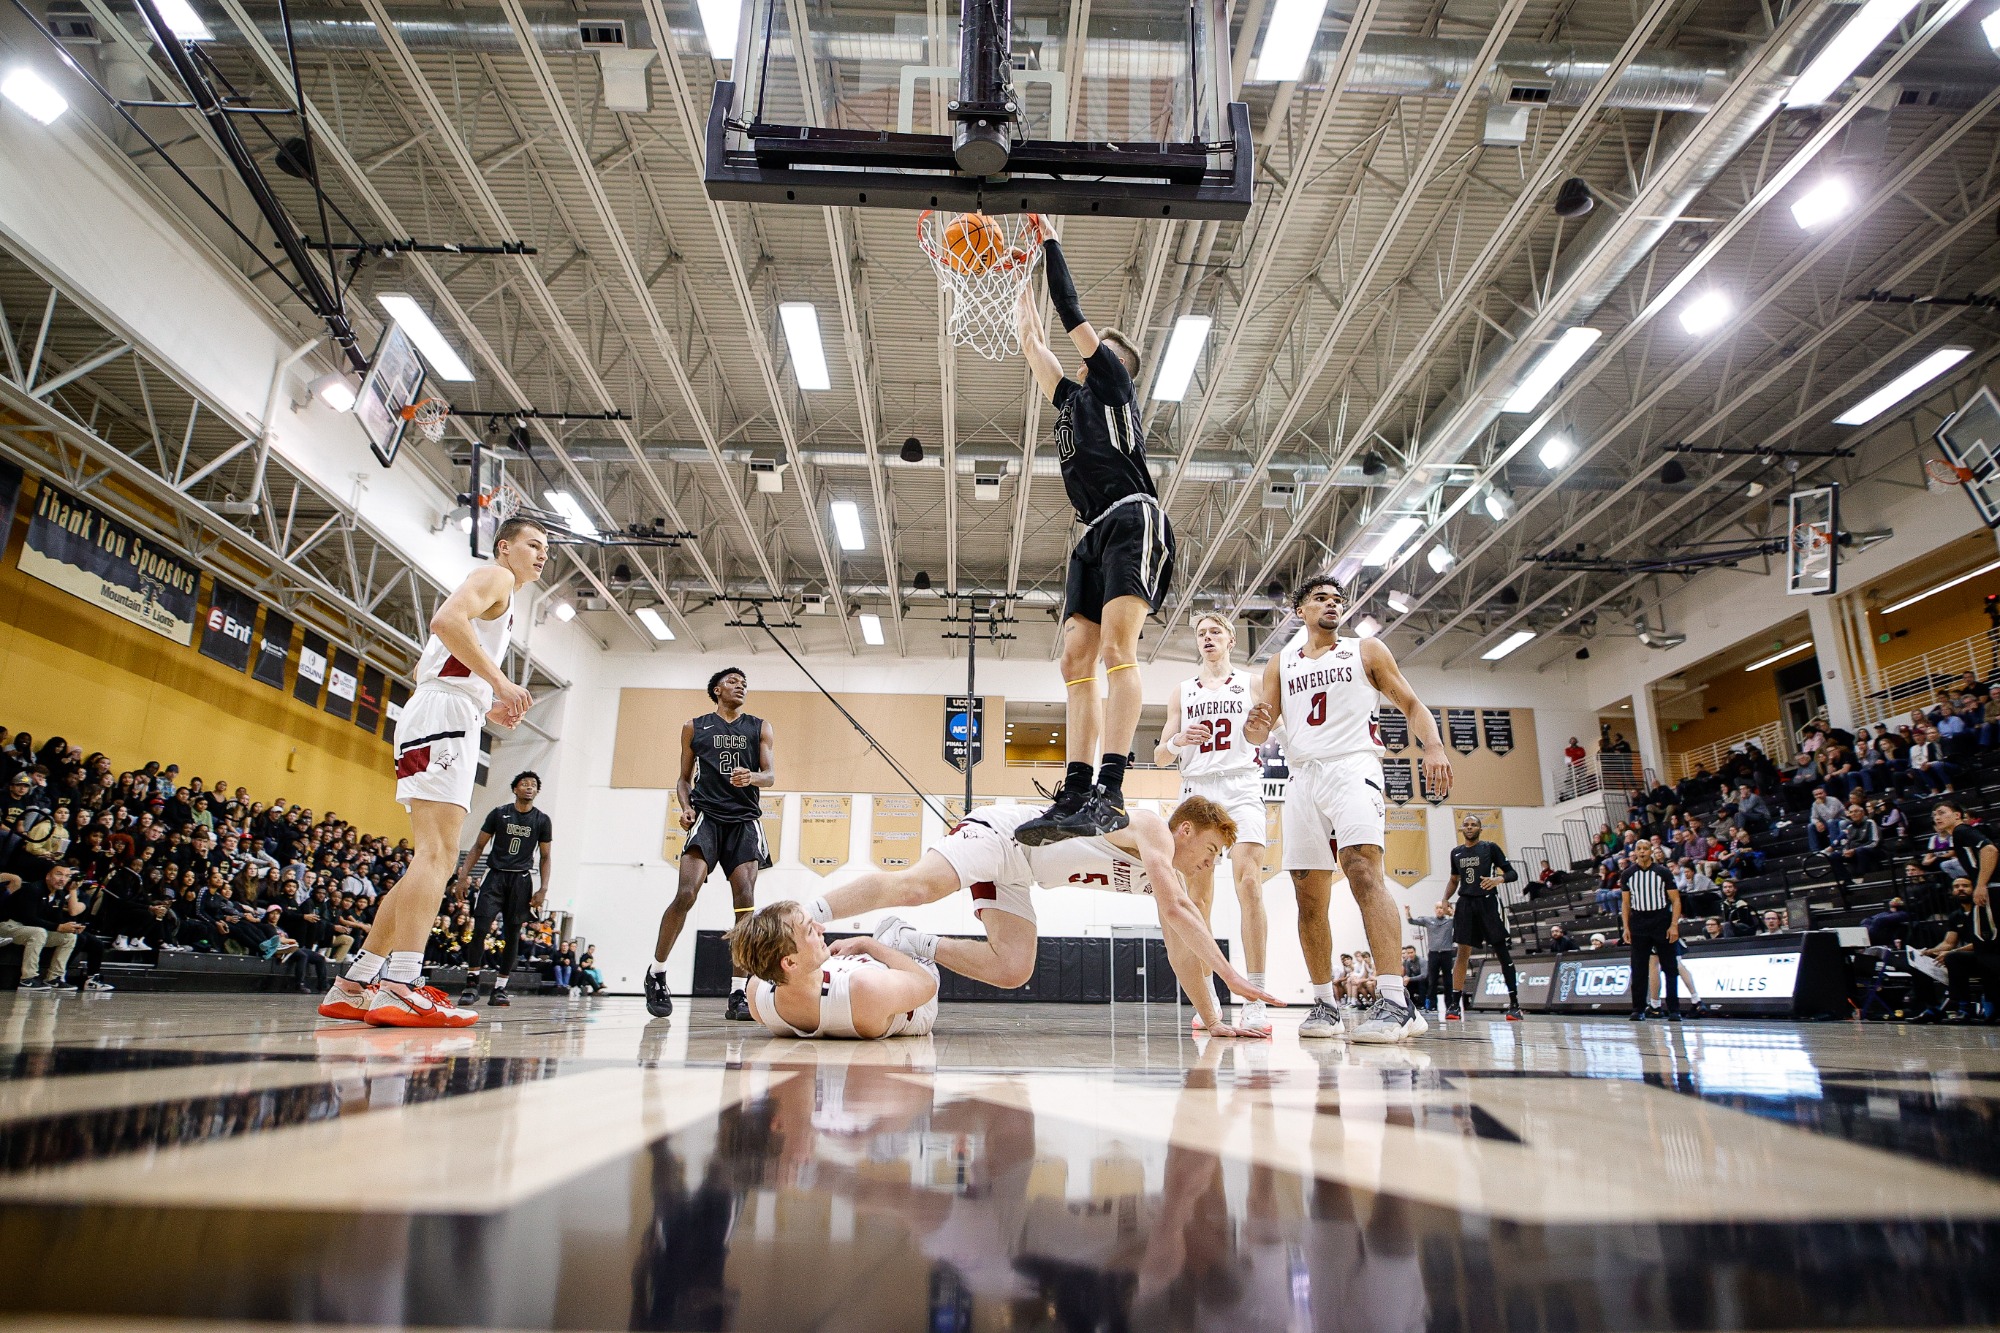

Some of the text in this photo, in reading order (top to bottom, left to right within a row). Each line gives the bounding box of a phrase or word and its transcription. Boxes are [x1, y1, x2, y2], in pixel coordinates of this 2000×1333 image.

[38, 486, 195, 596] Thank You Sponsors
[101, 584, 142, 613] Mountain
[152, 609, 175, 628] Lions
[223, 615, 252, 646] Ent
[1287, 666, 1353, 697] MAVERICKS
[1187, 700, 1243, 720] MAVERICKS
[1306, 691, 1327, 727] 0
[713, 734, 747, 750] UCCS
[1199, 718, 1232, 754] 22
[720, 751, 740, 775] 21
[506, 823, 532, 838] UCCS
[508, 837, 521, 855] 0
[1459, 856, 1480, 868] UCCS
[1465, 867, 1475, 884] 3
[1528, 976, 1551, 986] UCCS
[1575, 965, 1632, 996] UCCS
[1715, 977, 1768, 992] NILLES
